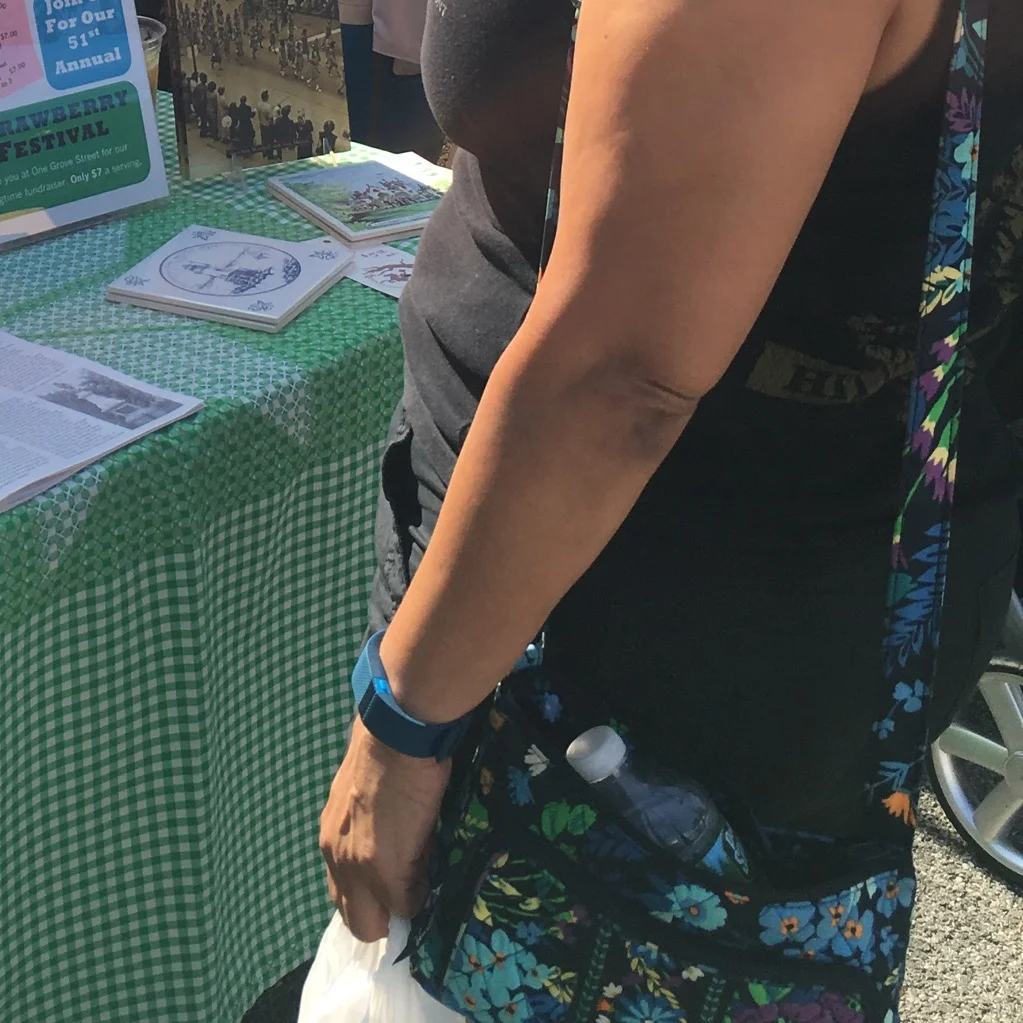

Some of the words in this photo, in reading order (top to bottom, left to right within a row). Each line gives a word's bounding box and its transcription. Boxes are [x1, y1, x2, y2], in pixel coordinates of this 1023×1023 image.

[45, 17, 76, 34] For
[81, 8, 115, 25] Our
[0, 30, 18, 41] $7.00
[68, 27, 100, 50] 51st
[8, 62, 26, 74] $7.00
[55, 47, 122, 76] Annual
[1, 81, 8, 89] to
[3, 173, 20, 186] you
[21, 170, 30, 180] at
[31, 165, 48, 176] One
[49, 159, 74, 172] Grove
[75, 151, 100, 164] Street
[102, 147, 113, 158] for
[114, 144, 128, 154] our
[70, 172, 90, 185] Only
[91, 167, 103, 179] $7
